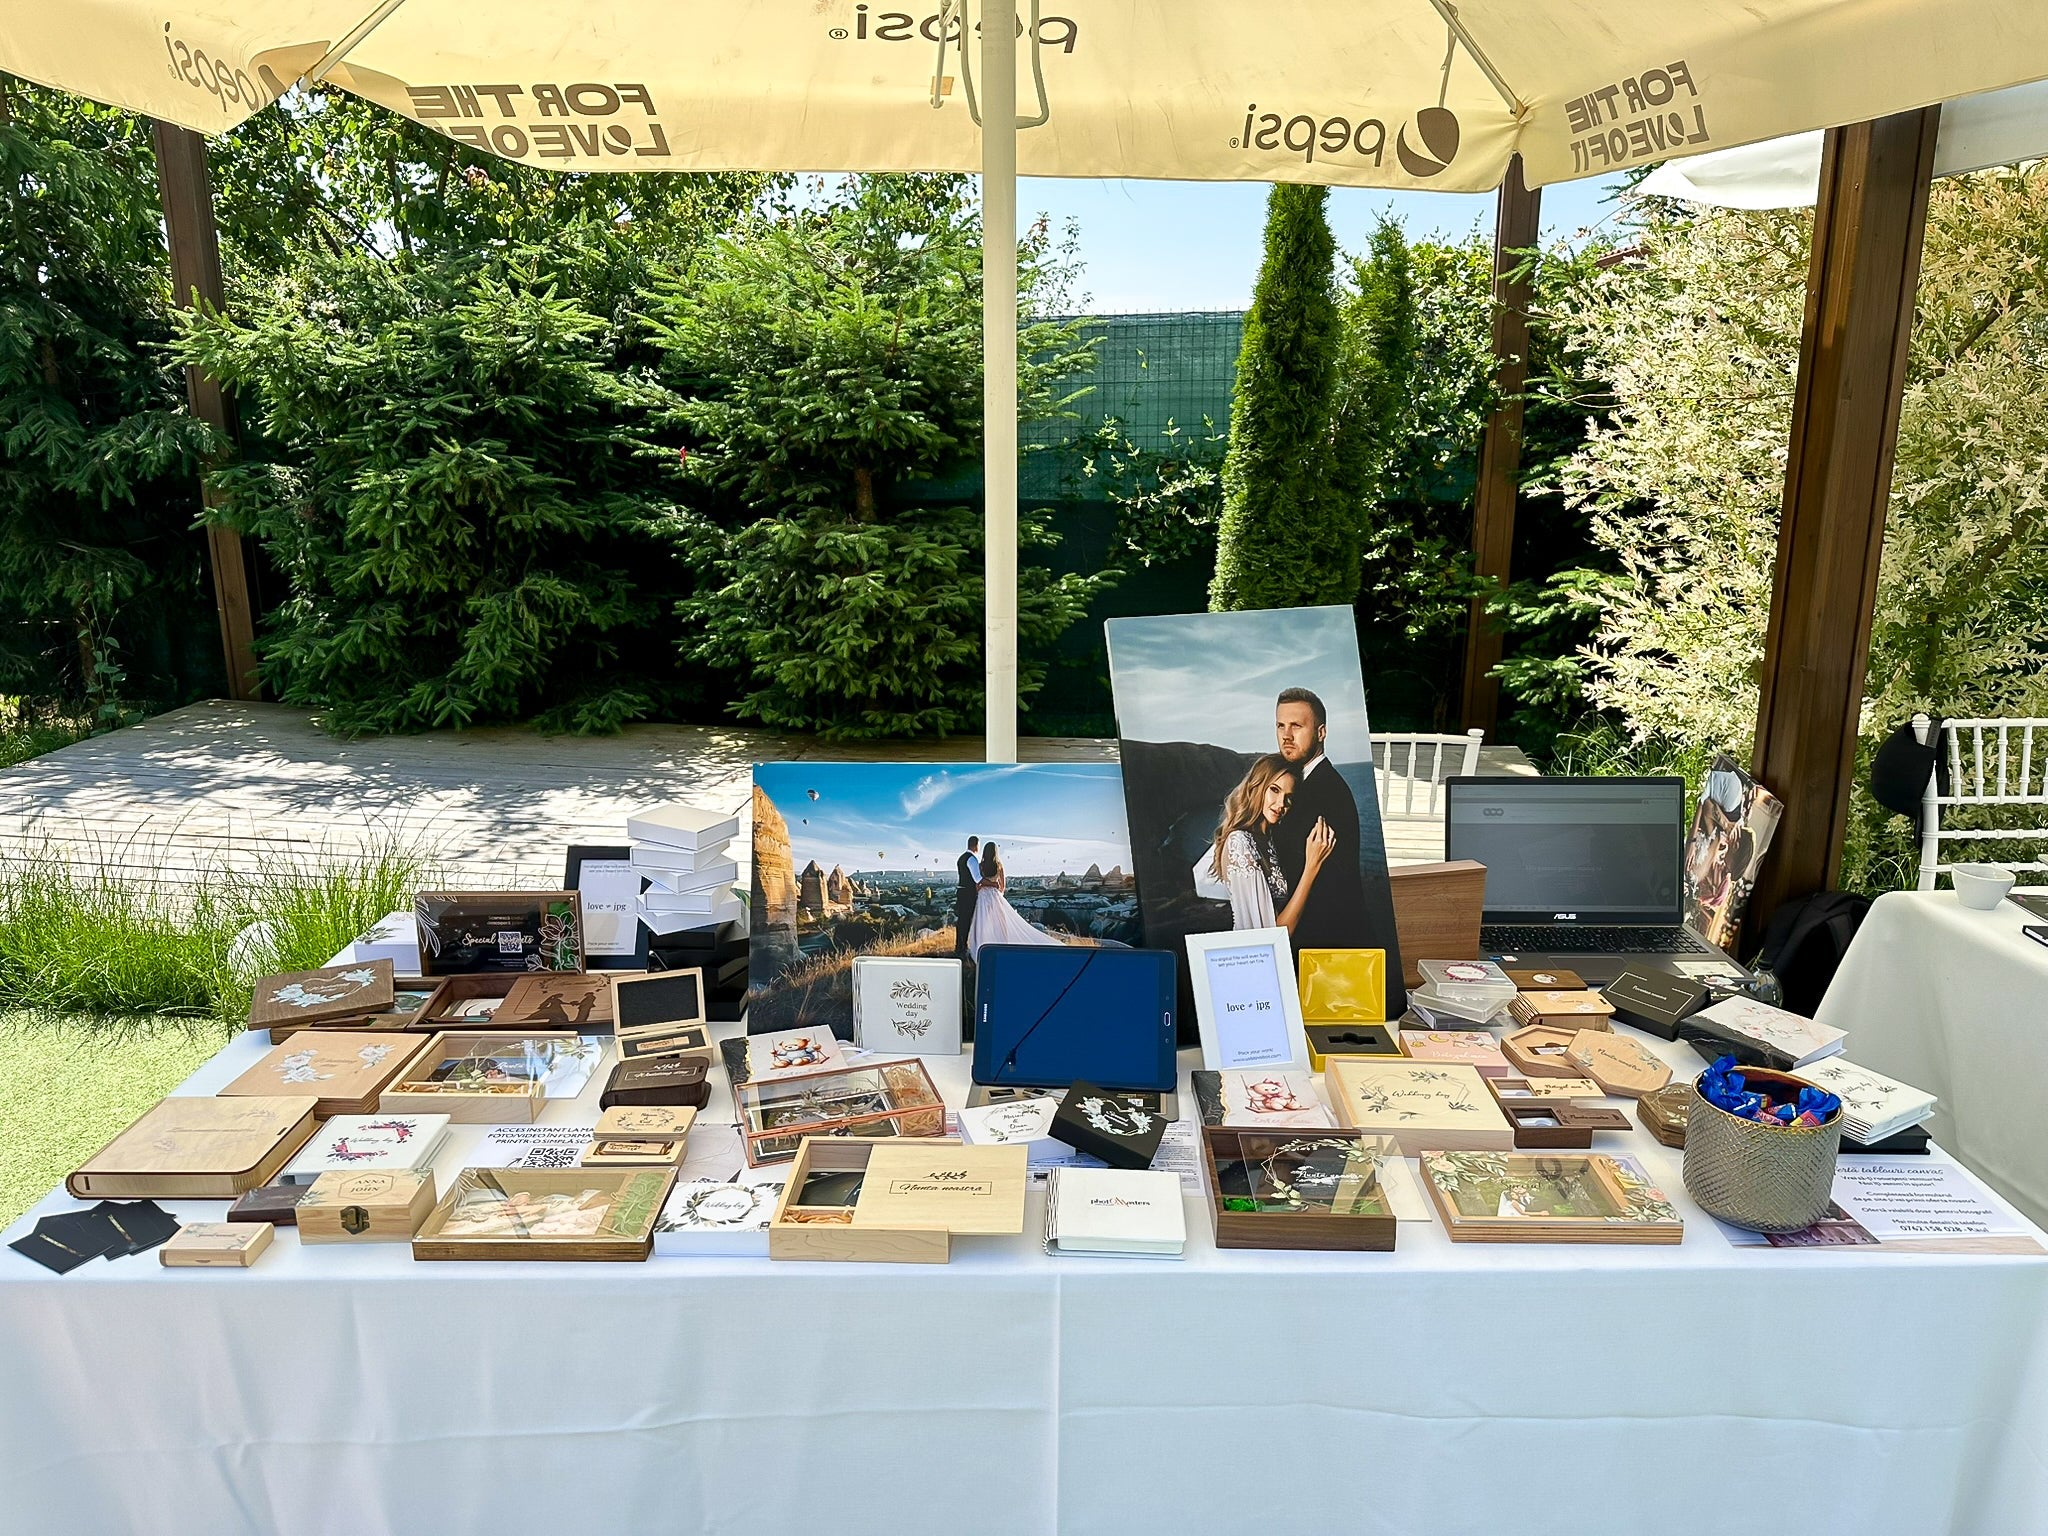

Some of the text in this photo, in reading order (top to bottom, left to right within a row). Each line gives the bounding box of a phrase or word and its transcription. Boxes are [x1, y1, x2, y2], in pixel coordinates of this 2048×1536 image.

[896, 1002, 927, 1011] Wedding
[1226, 1002, 1245, 1012] love
[1256, 1000, 1271, 1011] jpg
[905, 1010, 918, 1018] day
[1392, 1089, 1450, 1099] Wedding day
[899, 1183, 937, 1191] Nunta
